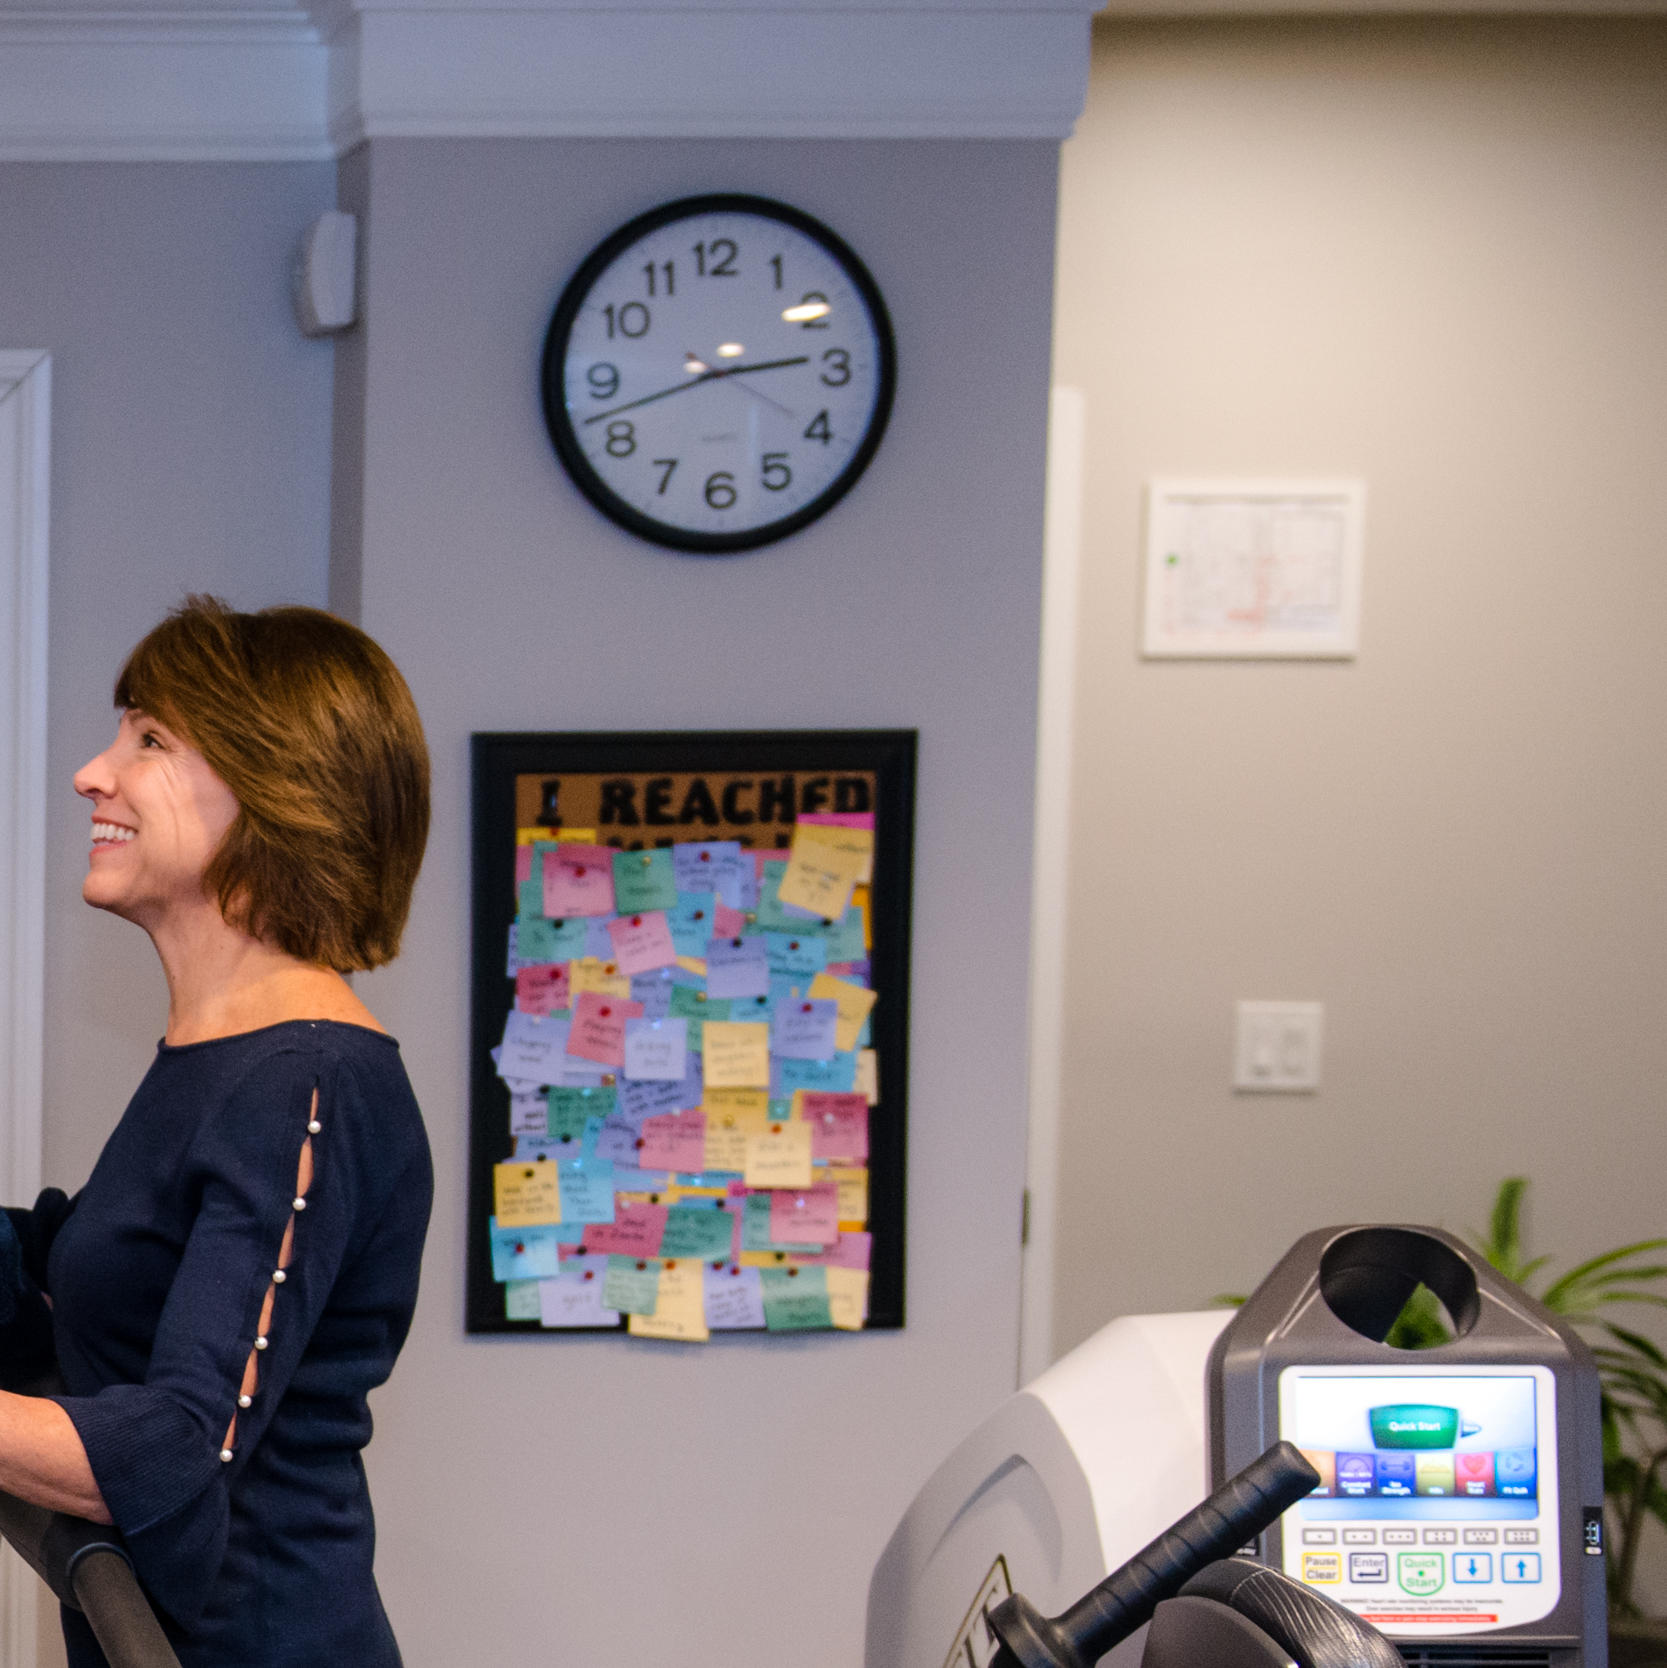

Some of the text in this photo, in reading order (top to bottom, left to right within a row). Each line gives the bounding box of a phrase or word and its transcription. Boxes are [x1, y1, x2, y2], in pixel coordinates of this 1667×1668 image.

[692, 238, 739, 277] 12
[770, 254, 783, 290] 1
[644, 260, 674, 297] 11
[603, 301, 651, 339] 10
[587, 362, 621, 400] 9
[821, 347, 852, 387] 3
[605, 419, 636, 458] 8
[804, 409, 833, 446] 4
[653, 458, 679, 495] 7
[704, 470, 738, 510] 6
[761, 452, 792, 492] 5
[535, 776, 872, 828] I REACHED
[1388, 1421, 1442, 1433] Quick Start
[1305, 1556, 1338, 1567] Pause
[1305, 1569, 1338, 1581] Clear
[1352, 1556, 1385, 1568] Enter
[1404, 1557, 1438, 1569] Quick
[1405, 1576, 1438, 1588] Start
